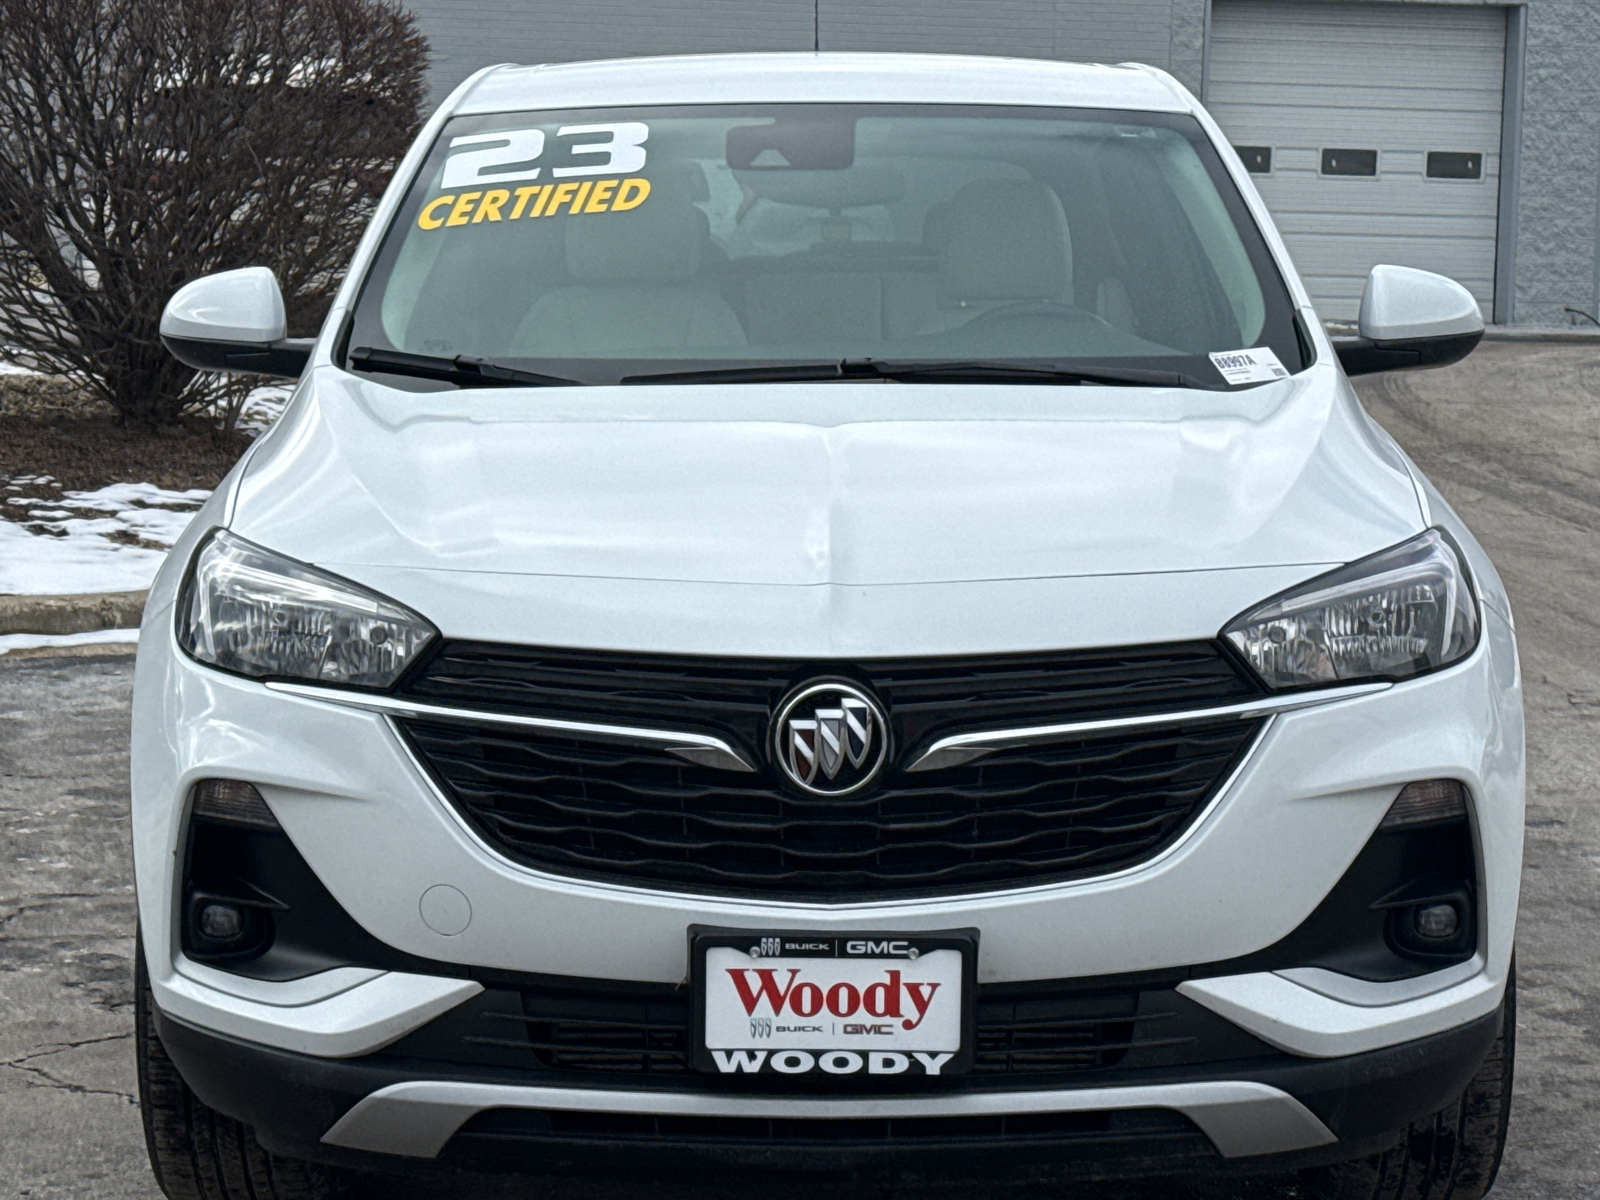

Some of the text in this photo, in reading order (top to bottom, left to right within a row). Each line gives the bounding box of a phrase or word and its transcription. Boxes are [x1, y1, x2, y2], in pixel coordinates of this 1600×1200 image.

[441, 122, 649, 189] 23
[418, 178, 651, 230] CERTIFIED
[846, 941, 909, 954] GMC
[725, 969, 942, 1031] Woody
[775, 1024, 894, 1035] BUICK GMC
[711, 1050, 955, 1075] WOODY
